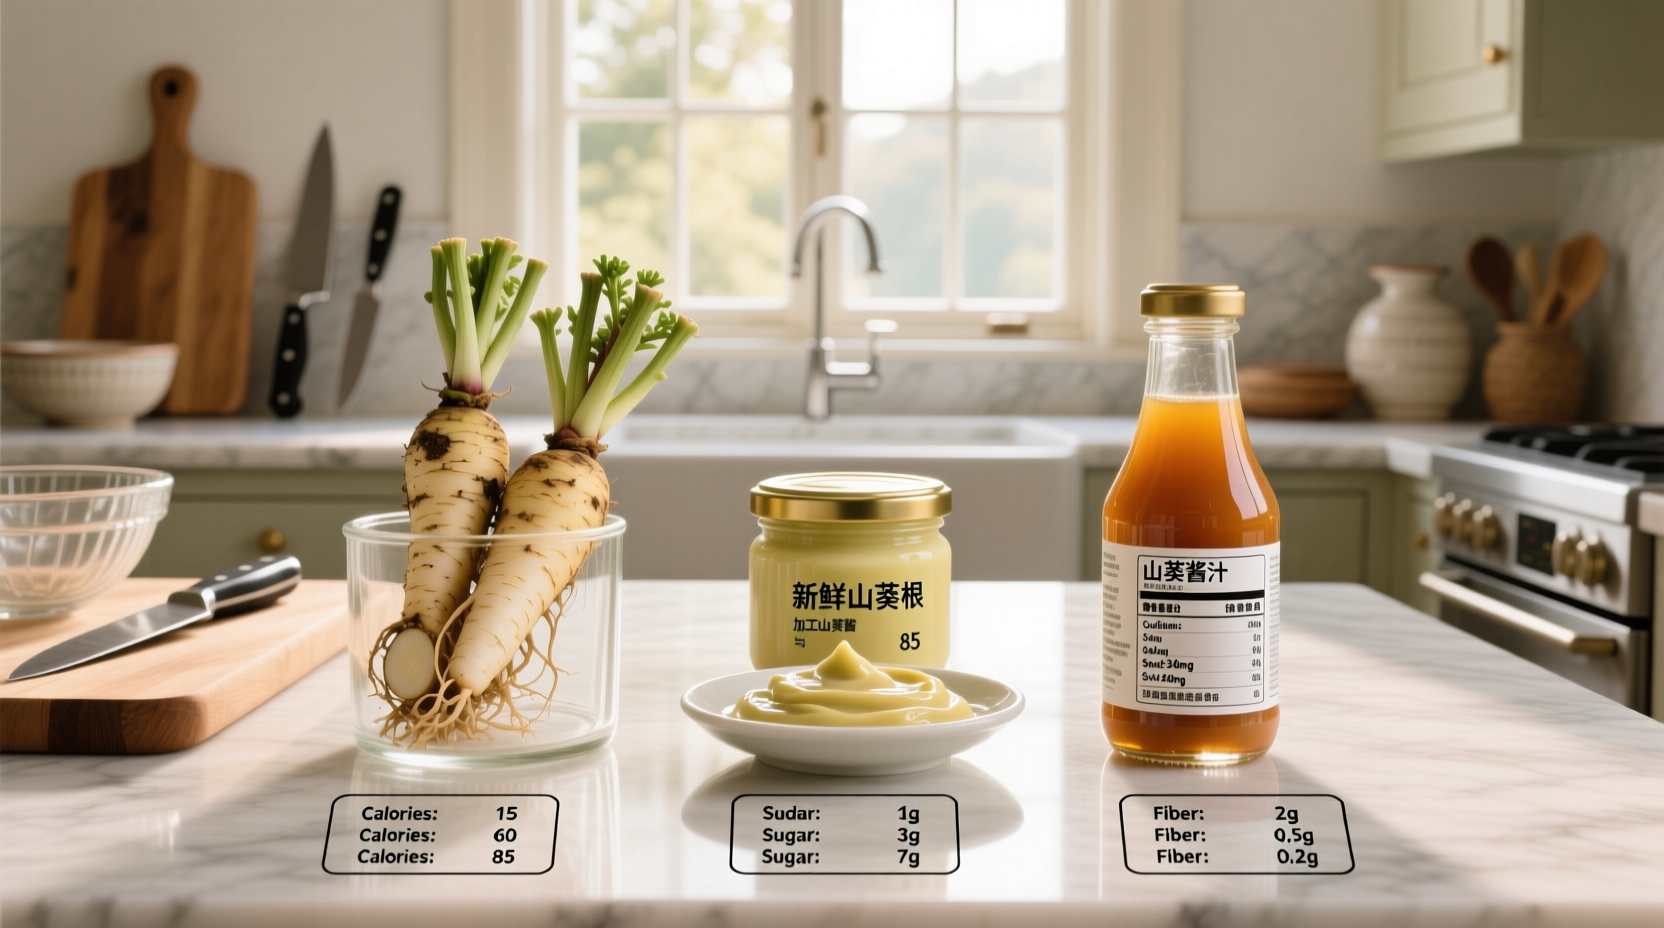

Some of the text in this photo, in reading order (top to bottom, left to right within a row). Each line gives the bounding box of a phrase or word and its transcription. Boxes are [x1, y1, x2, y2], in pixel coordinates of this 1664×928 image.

[1144, 560, 1228, 583] 山葵酱汁
[792, 581, 924, 610] 新鲜山葵根
[900, 632, 921, 651] 85
